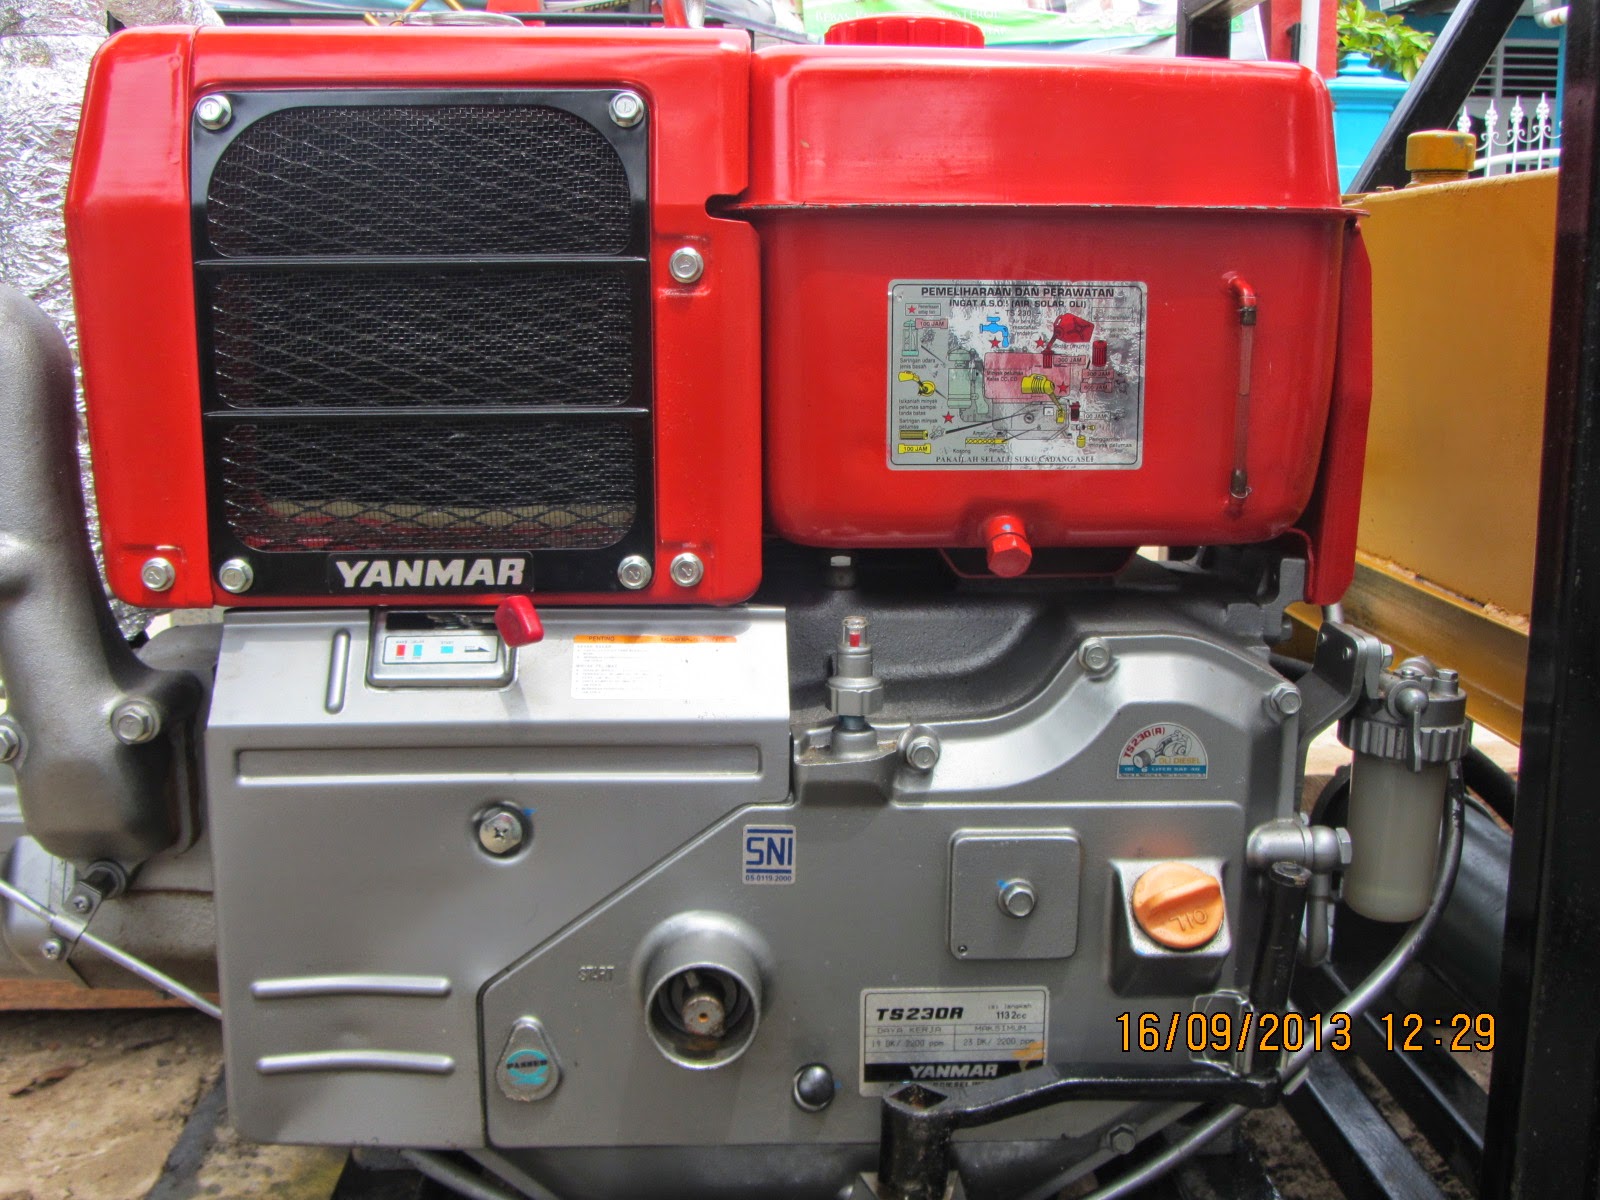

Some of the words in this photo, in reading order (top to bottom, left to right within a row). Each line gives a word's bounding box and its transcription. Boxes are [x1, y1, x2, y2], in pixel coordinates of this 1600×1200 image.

[921, 287, 1011, 297] PEMELIHARAAN
[1014, 287, 1040, 297] DAN
[1043, 287, 1115, 297] PERAWATAN
[949, 299, 977, 307] INGAT
[336, 558, 525, 588] YANMAR
[746, 837, 793, 866] SNI
[1168, 908, 1207, 932] OIL
[876, 1007, 964, 1021] TS230R
[910, 1063, 998, 1079] YANMAR
